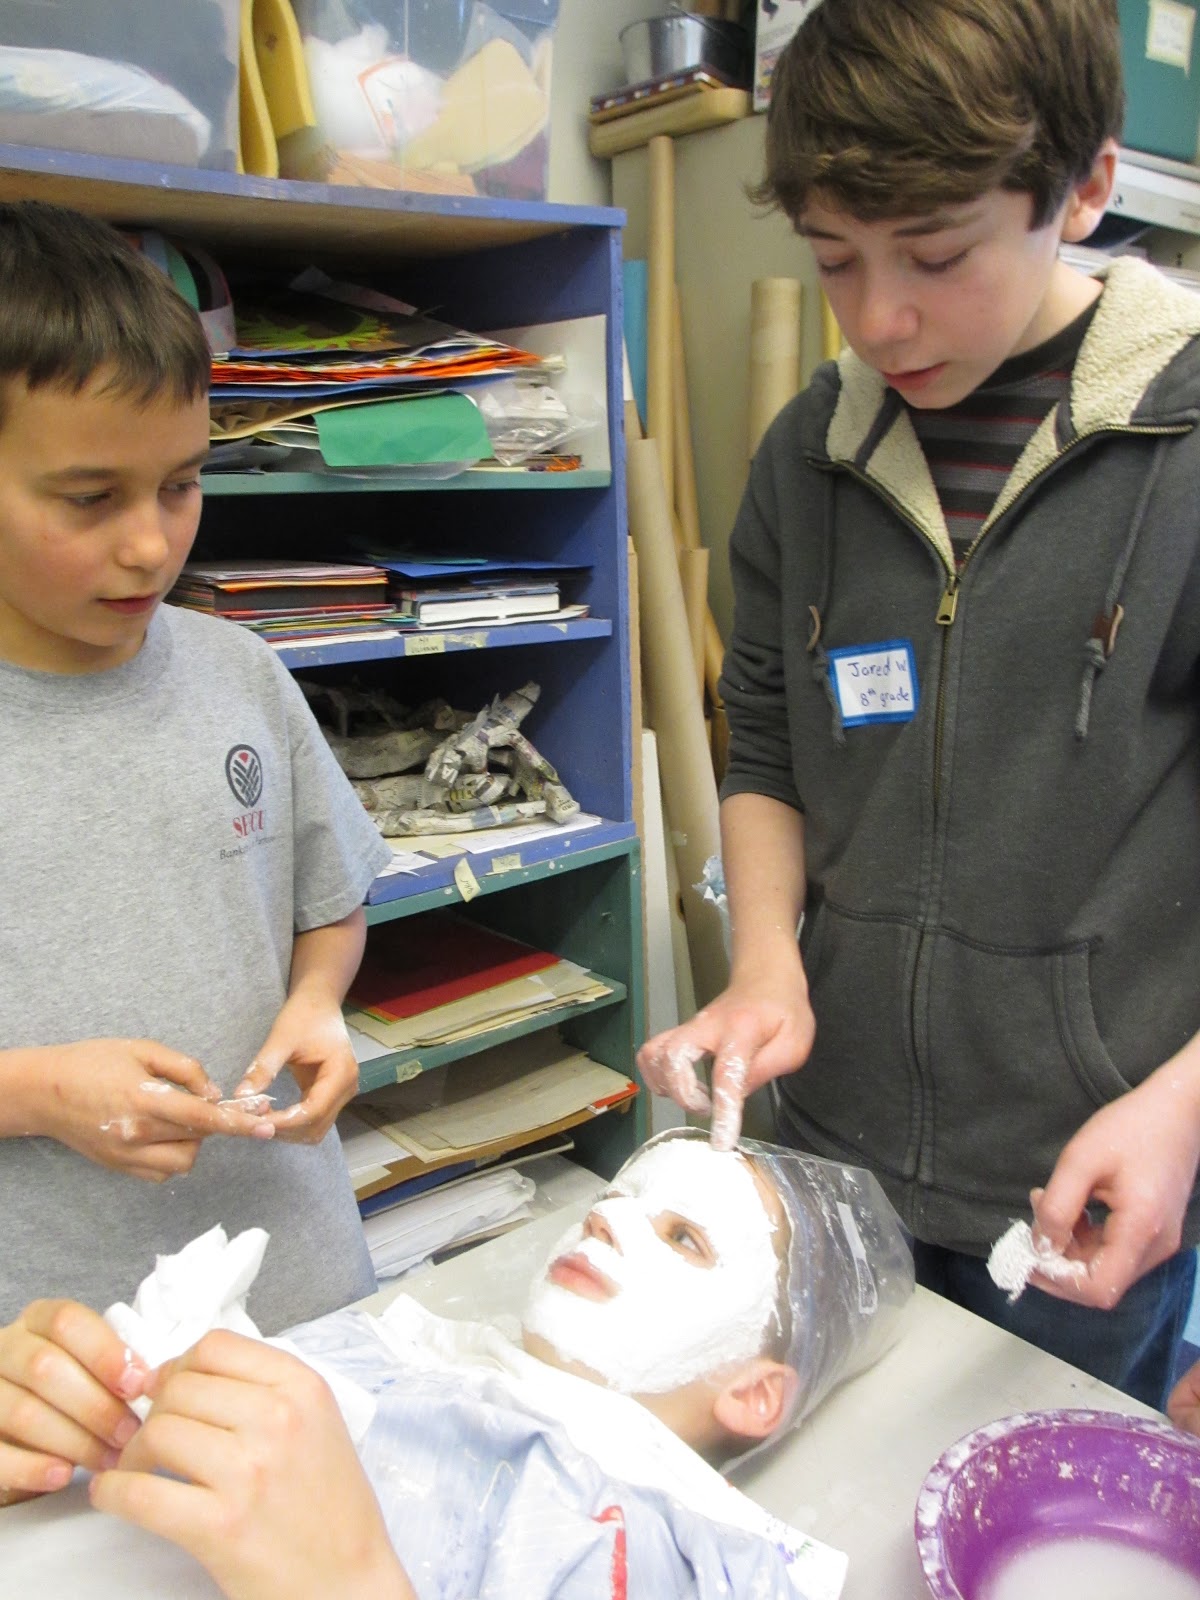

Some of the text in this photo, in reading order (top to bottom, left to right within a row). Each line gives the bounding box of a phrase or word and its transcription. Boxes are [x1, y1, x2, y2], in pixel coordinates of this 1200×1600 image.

[847, 655, 891, 677] Jared
[860, 686, 909, 707] 8th grade
